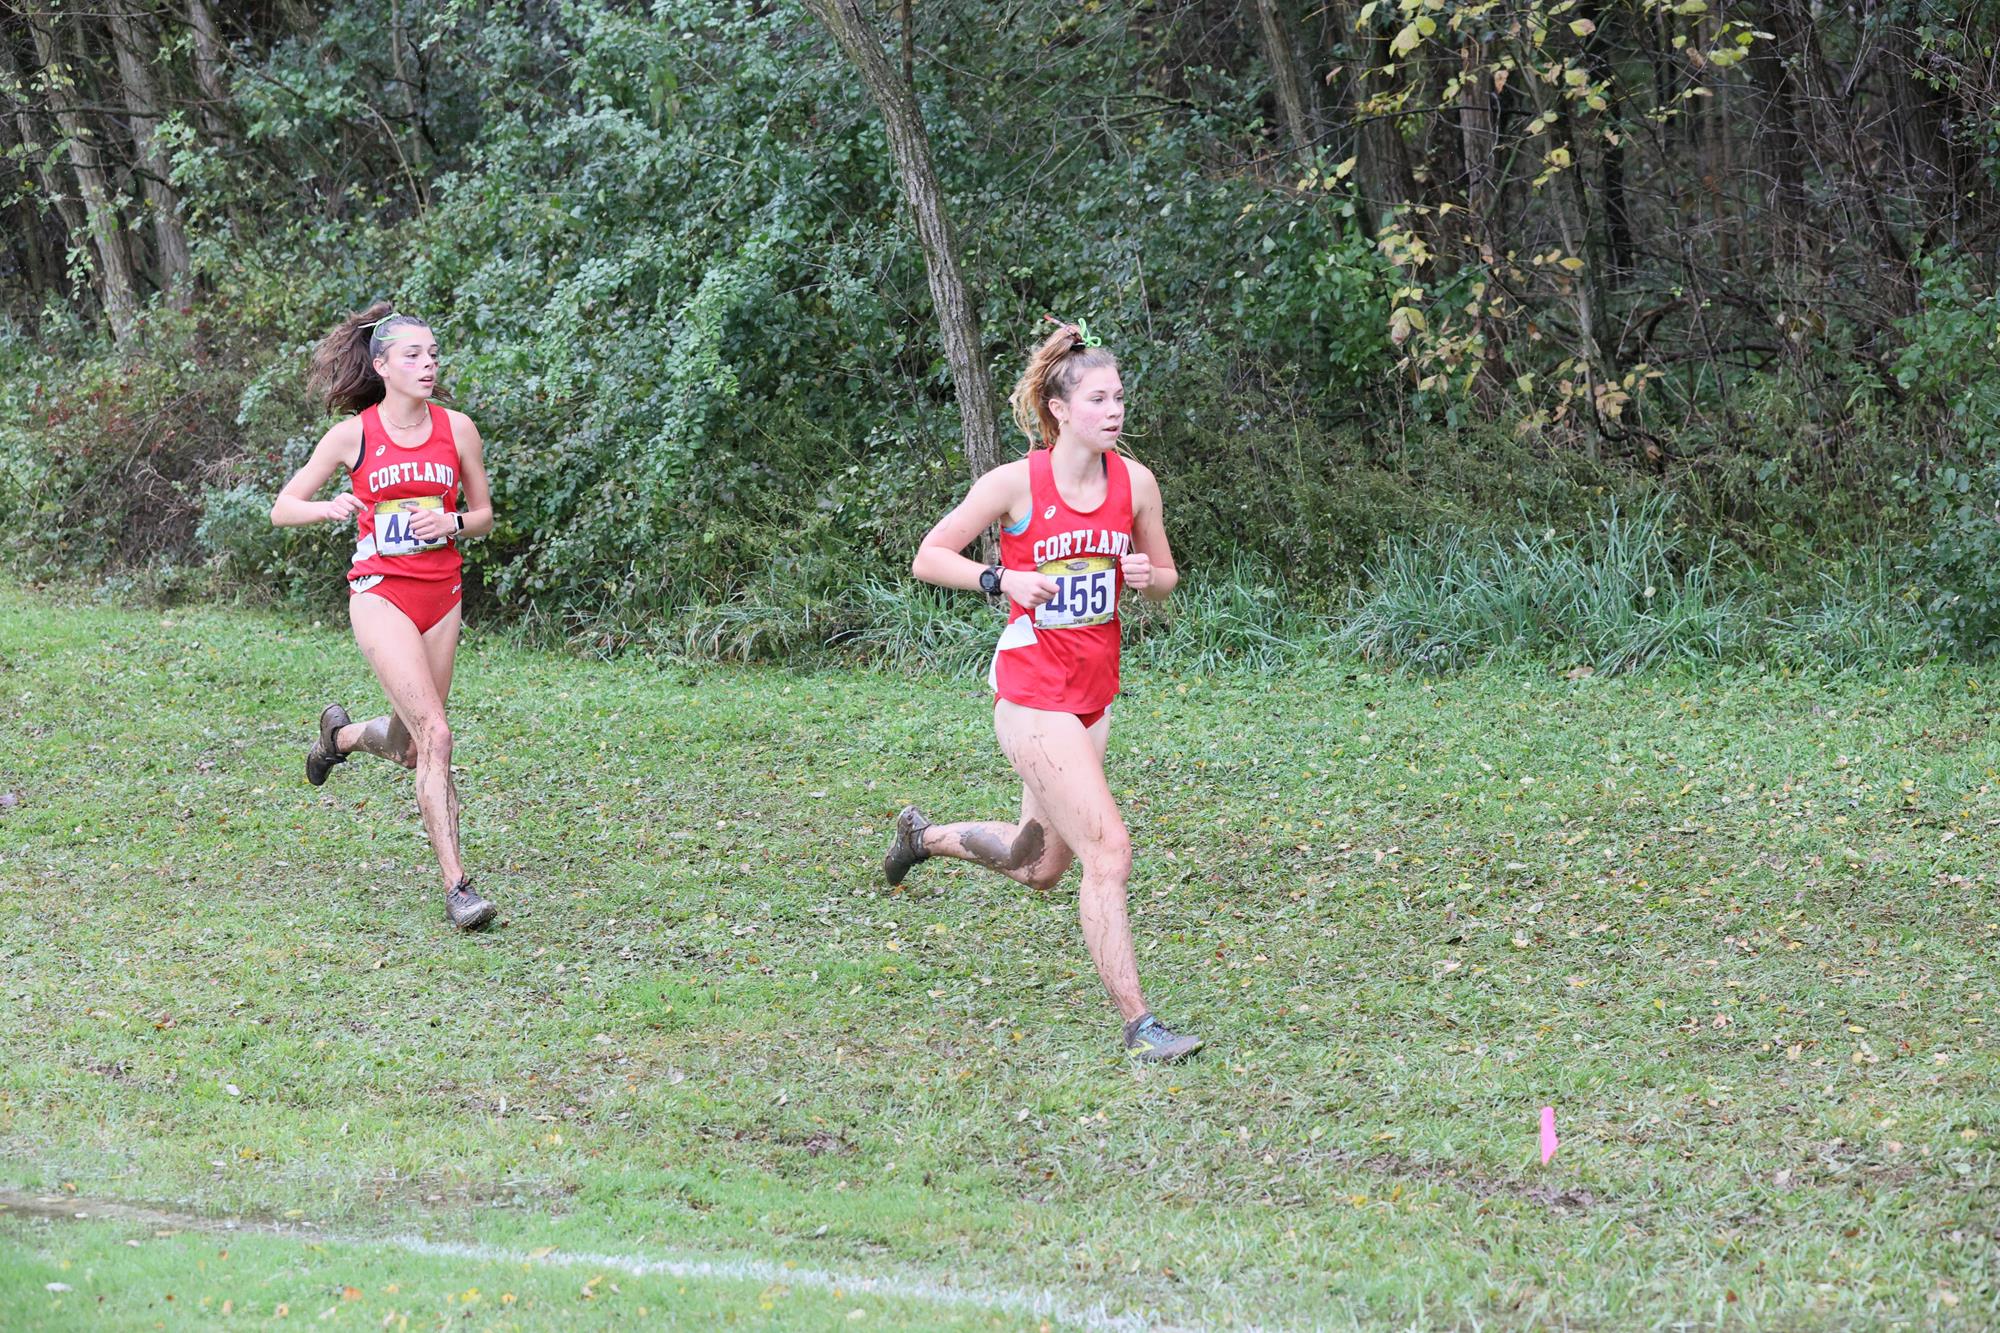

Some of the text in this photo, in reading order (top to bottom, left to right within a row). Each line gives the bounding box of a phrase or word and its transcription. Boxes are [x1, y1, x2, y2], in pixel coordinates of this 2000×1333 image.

[368, 461, 454, 493] CORTLAND
[384, 512, 439, 546] 44
[1033, 529, 1130, 563] CORTLAND
[1045, 572, 1107, 617] 455
